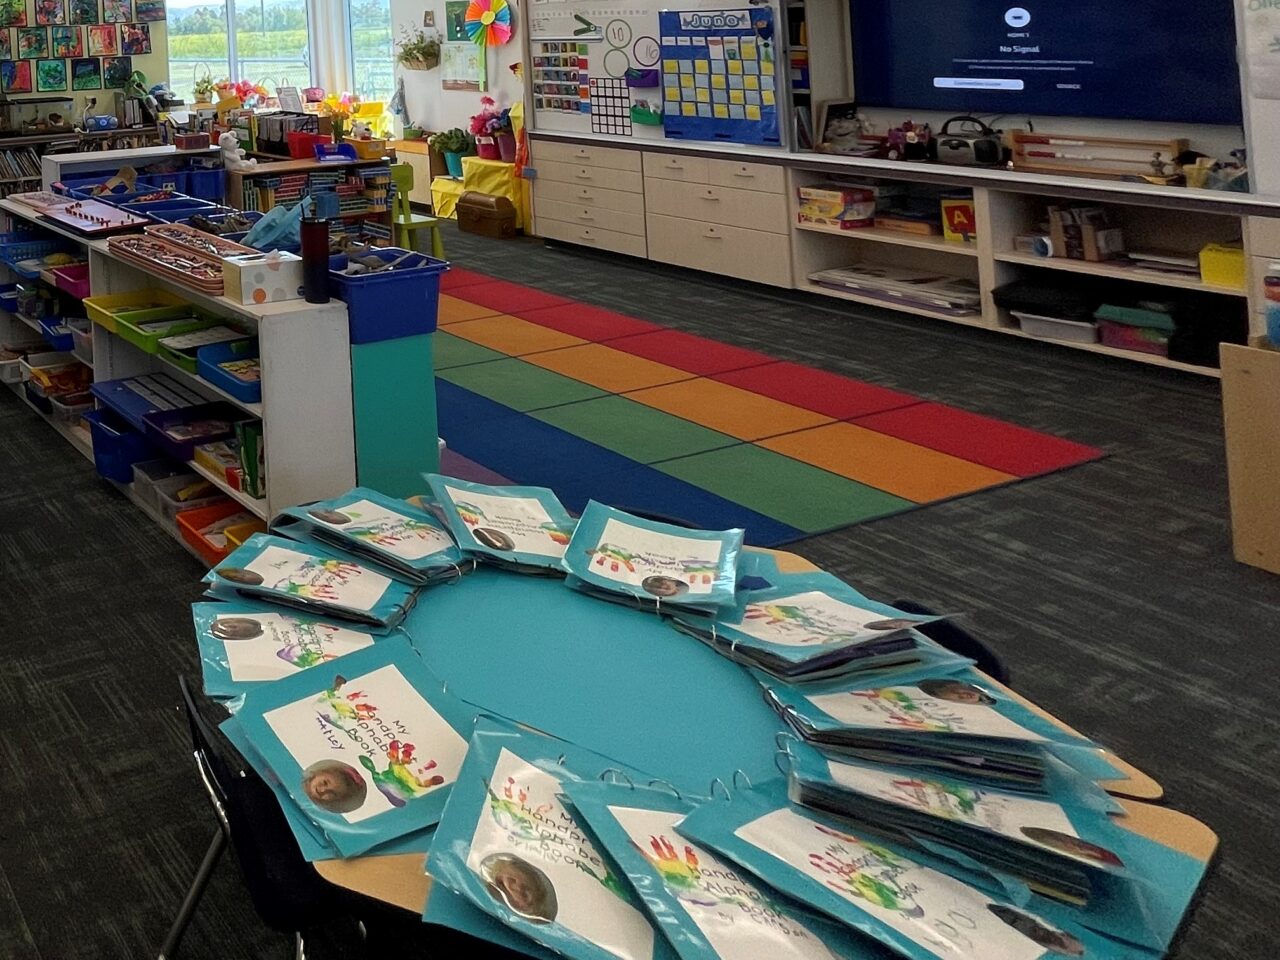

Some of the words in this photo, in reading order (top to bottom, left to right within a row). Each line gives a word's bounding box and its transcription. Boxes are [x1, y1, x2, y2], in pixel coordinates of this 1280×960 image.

[999, 45, 1012, 53] No
[1012, 45, 1040, 54] Signal
[953, 210, 969, 225] A
[392, 719, 411, 736] My
[347, 727, 377, 758] Book
